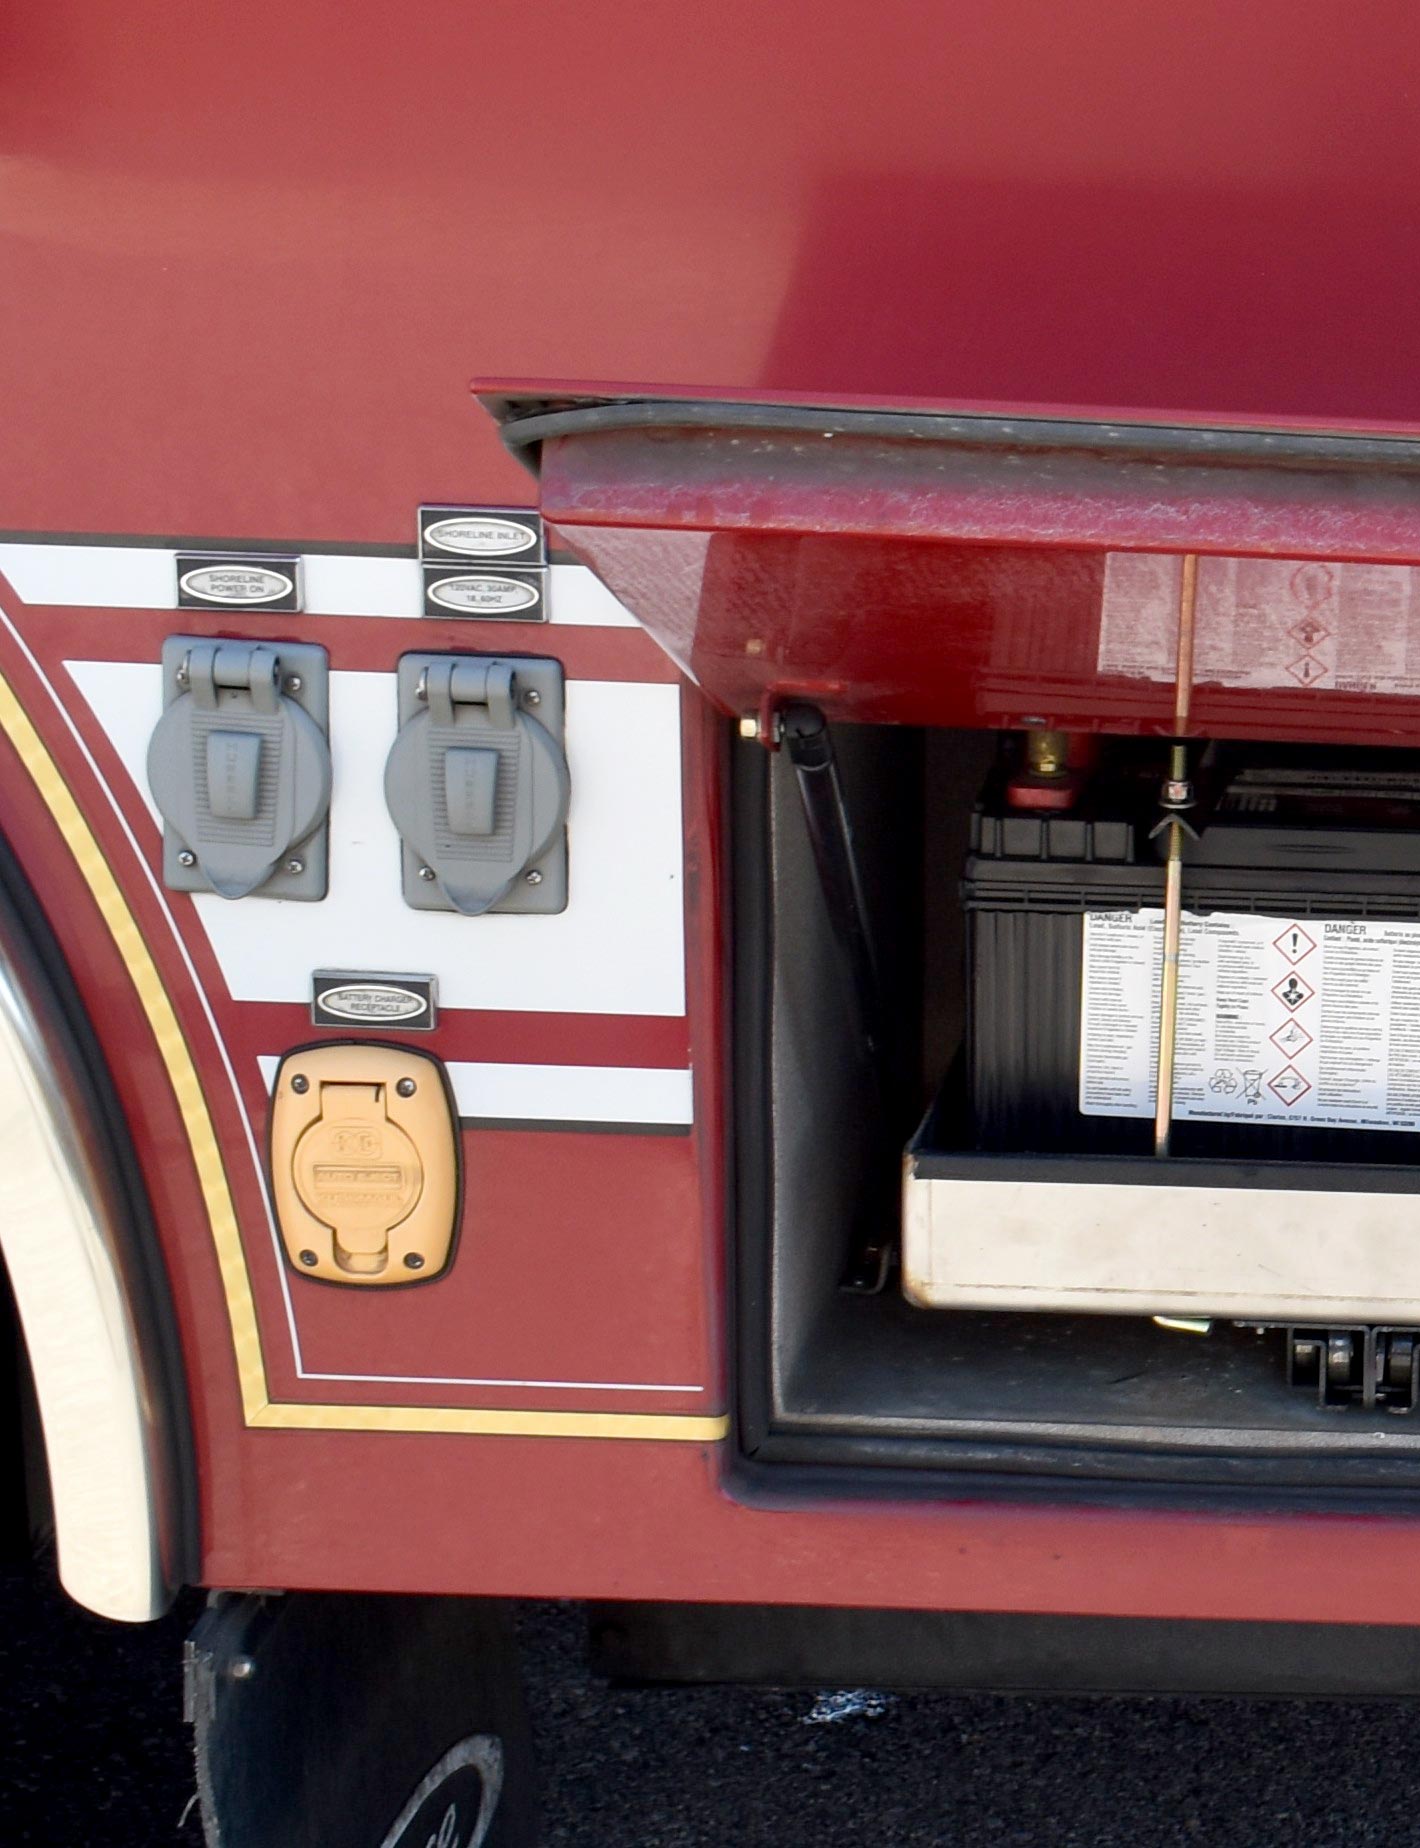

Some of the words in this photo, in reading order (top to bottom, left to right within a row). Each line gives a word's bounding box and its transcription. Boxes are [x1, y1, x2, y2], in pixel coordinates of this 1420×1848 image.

[436, 529, 494, 540] SHORELINE
[496, 530, 526, 540] INLET
[208, 574, 265, 584] SHORELINE
[210, 584, 247, 593] POWER
[249, 584, 265, 593] ON
[1324, 923, 1367, 935] DANGER
[338, 992, 371, 1001] BATTERY
[350, 1003, 401, 1012] RECEPTACLE
